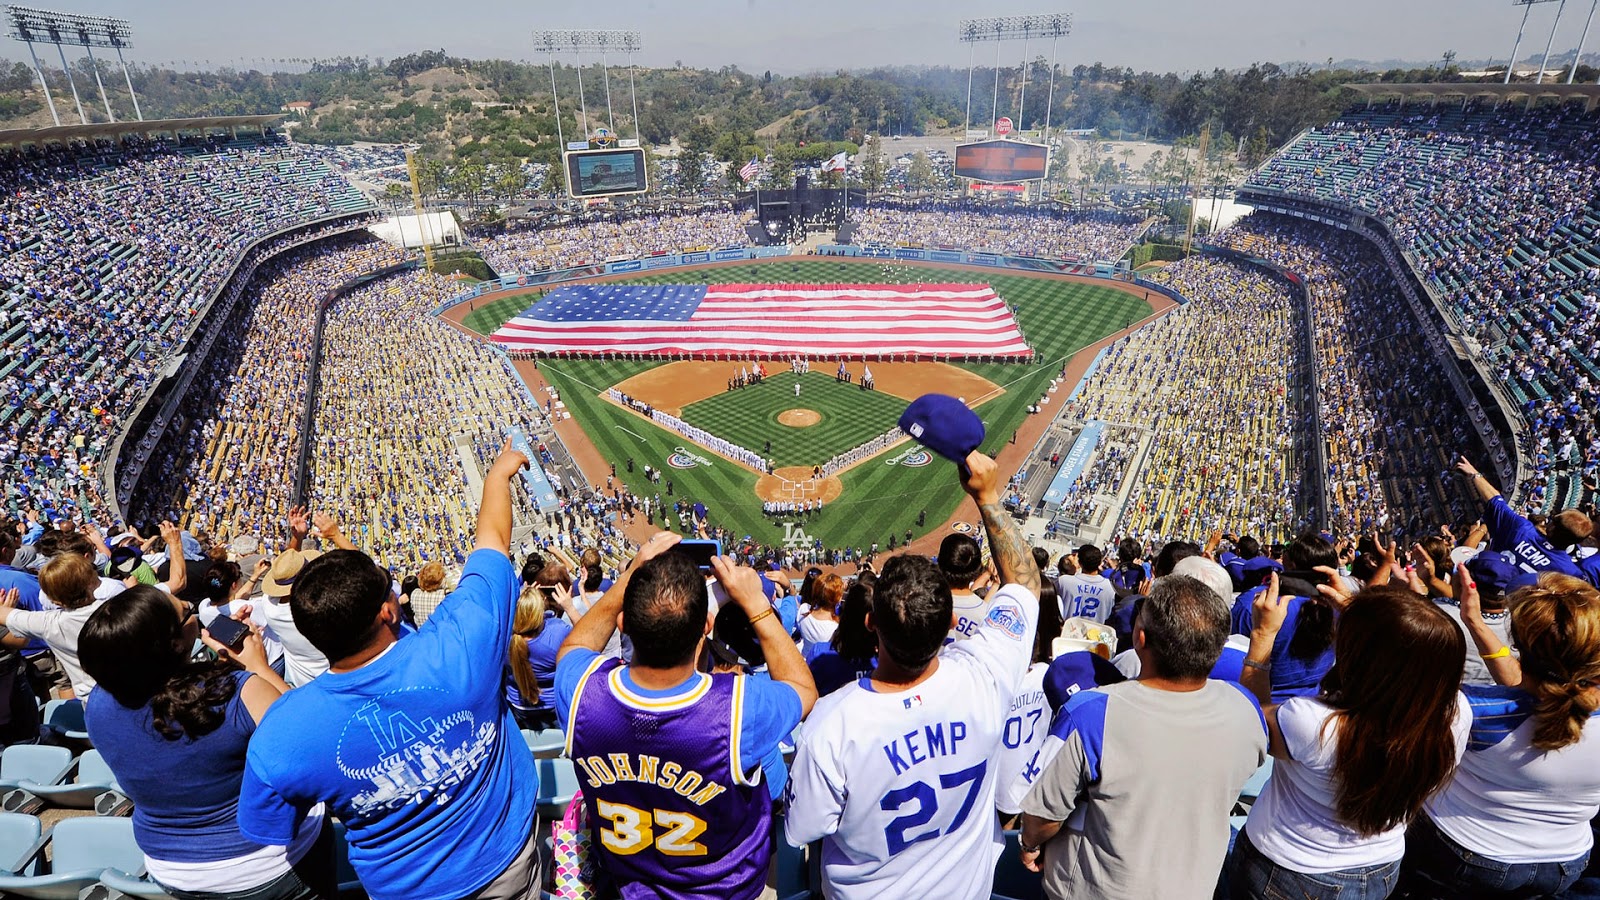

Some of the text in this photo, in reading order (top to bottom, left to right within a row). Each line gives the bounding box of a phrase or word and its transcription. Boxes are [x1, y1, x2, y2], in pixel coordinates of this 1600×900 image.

[1060, 437, 1089, 479] DODGER STADIUM
[782, 523, 813, 548] LA
[1514, 541, 1551, 567] KEMP
[1072, 596, 1100, 618] 12
[1077, 584, 1104, 597] KENT
[956, 616, 978, 637] SE
[1010, 690, 1045, 712] SUTLIFF
[356, 701, 441, 762] LA
[883, 722, 967, 776] KEMP
[1002, 708, 1042, 749] 07
[576, 752, 727, 806] JOHNSON
[596, 797, 708, 857] 32
[879, 759, 988, 857] 27
